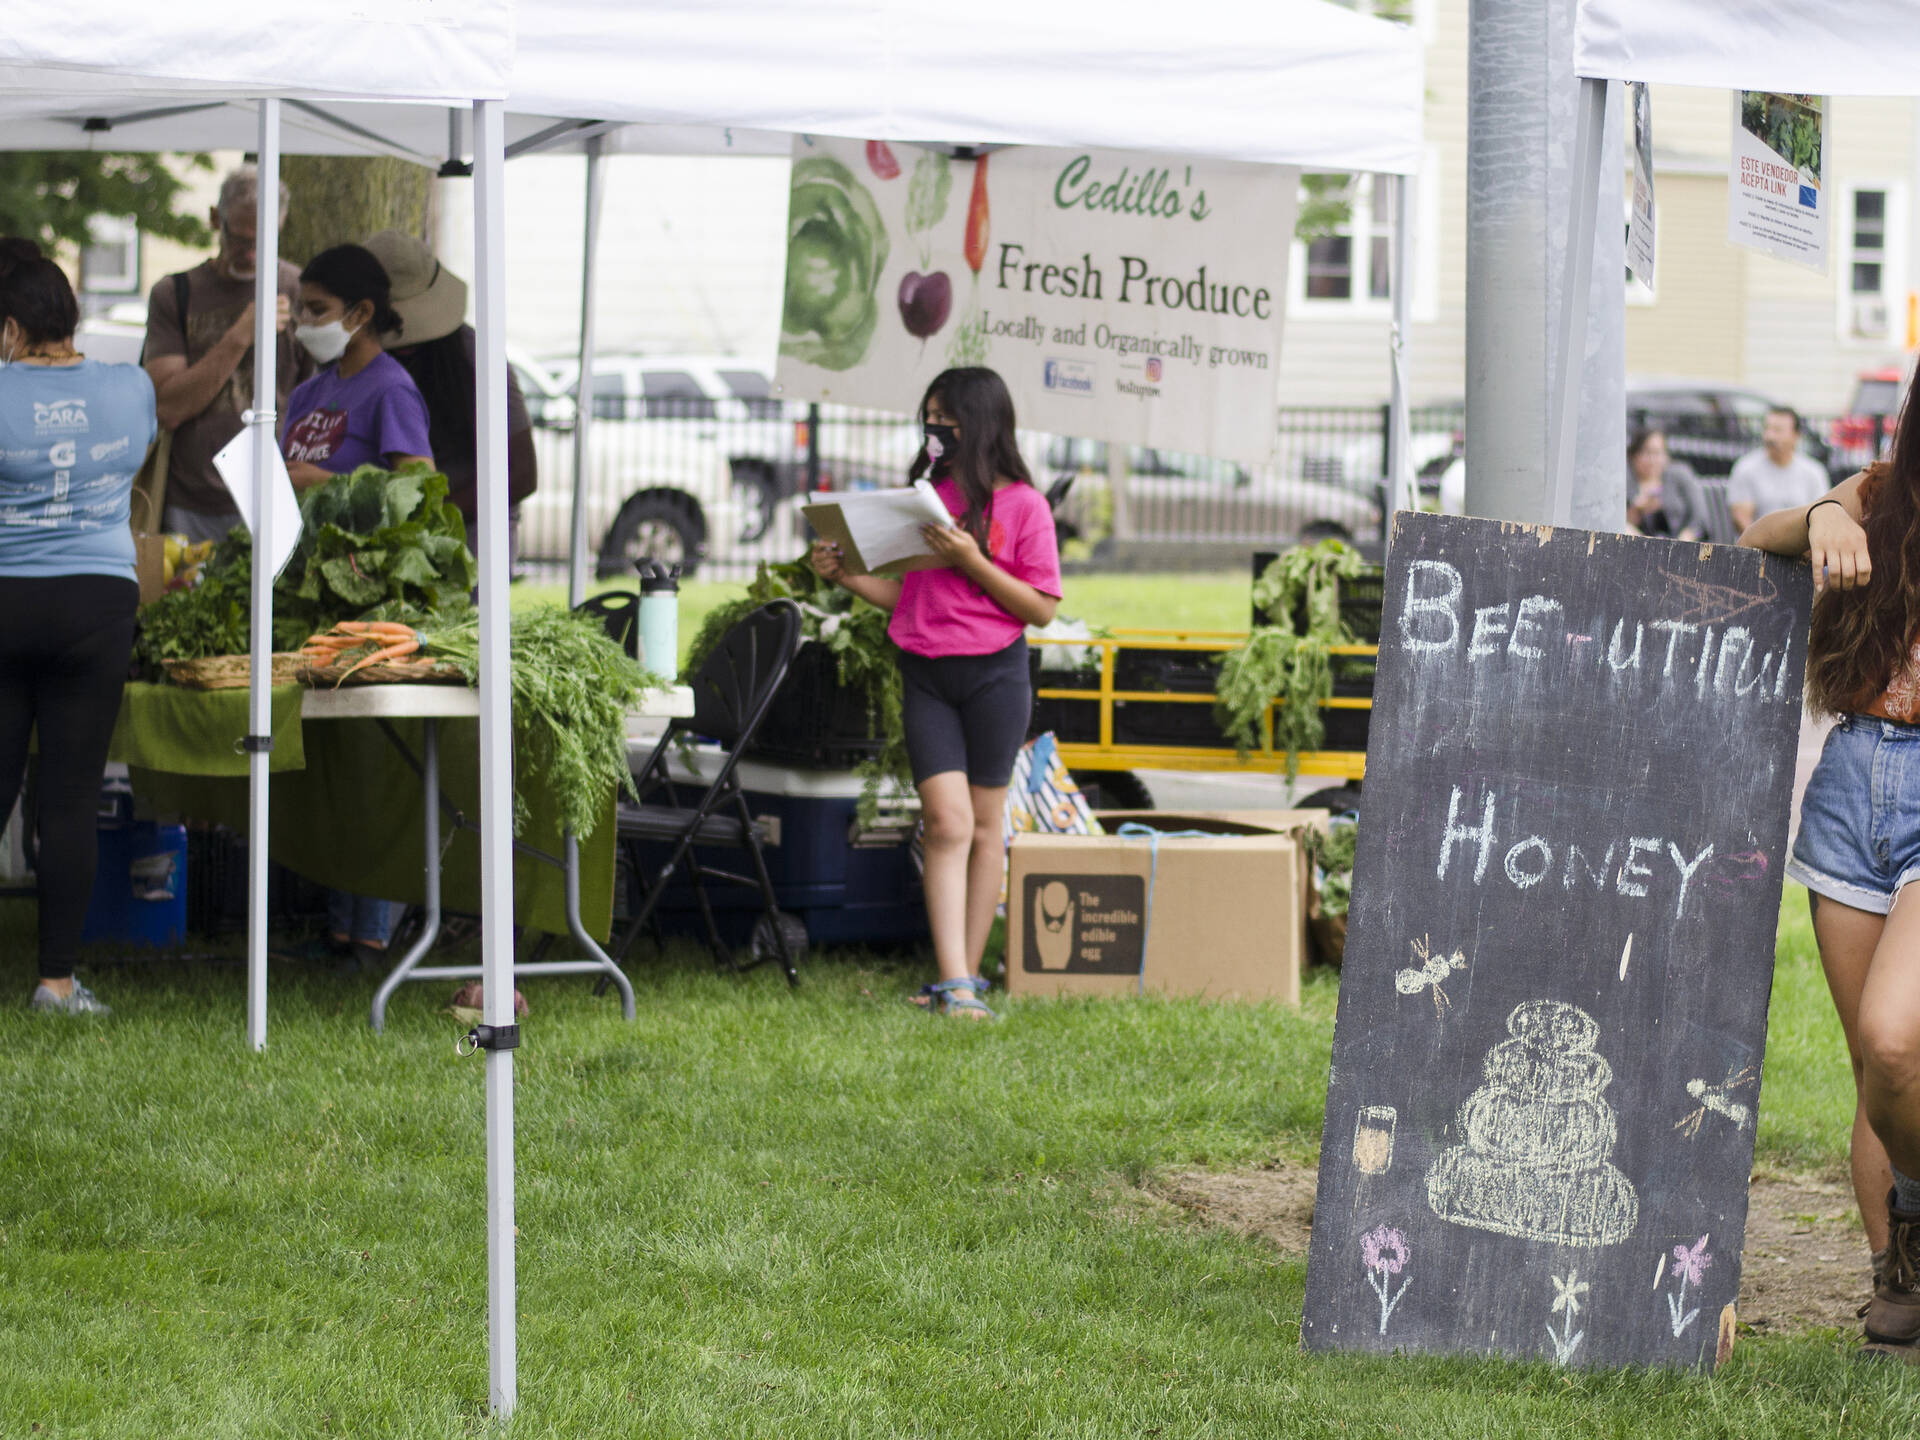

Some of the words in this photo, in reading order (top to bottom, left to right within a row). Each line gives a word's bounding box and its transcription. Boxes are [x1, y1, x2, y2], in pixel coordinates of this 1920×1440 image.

[1741, 156, 1759, 174] ESTE
[1761, 161, 1799, 185] VENDEDOR
[1054, 154, 1211, 221] Cedillo's
[1740, 172, 1769, 192] ACEPTA
[1770, 180, 1787, 197] LINK
[996, 243, 1103, 300] Fresh
[1117, 255, 1271, 320] Produce
[981, 310, 1045, 346] Locally
[1052, 323, 1086, 346] and
[1094, 323, 1205, 366] Organically
[1208, 345, 1269, 370] grown
[33, 408, 88, 425] CARA
[1436, 783, 1714, 919] HONEY
[1079, 892, 1100, 907] The
[1081, 909, 1138, 925] incredible
[1081, 927, 1116, 942] edible
[1081, 948, 1102, 961] egg
